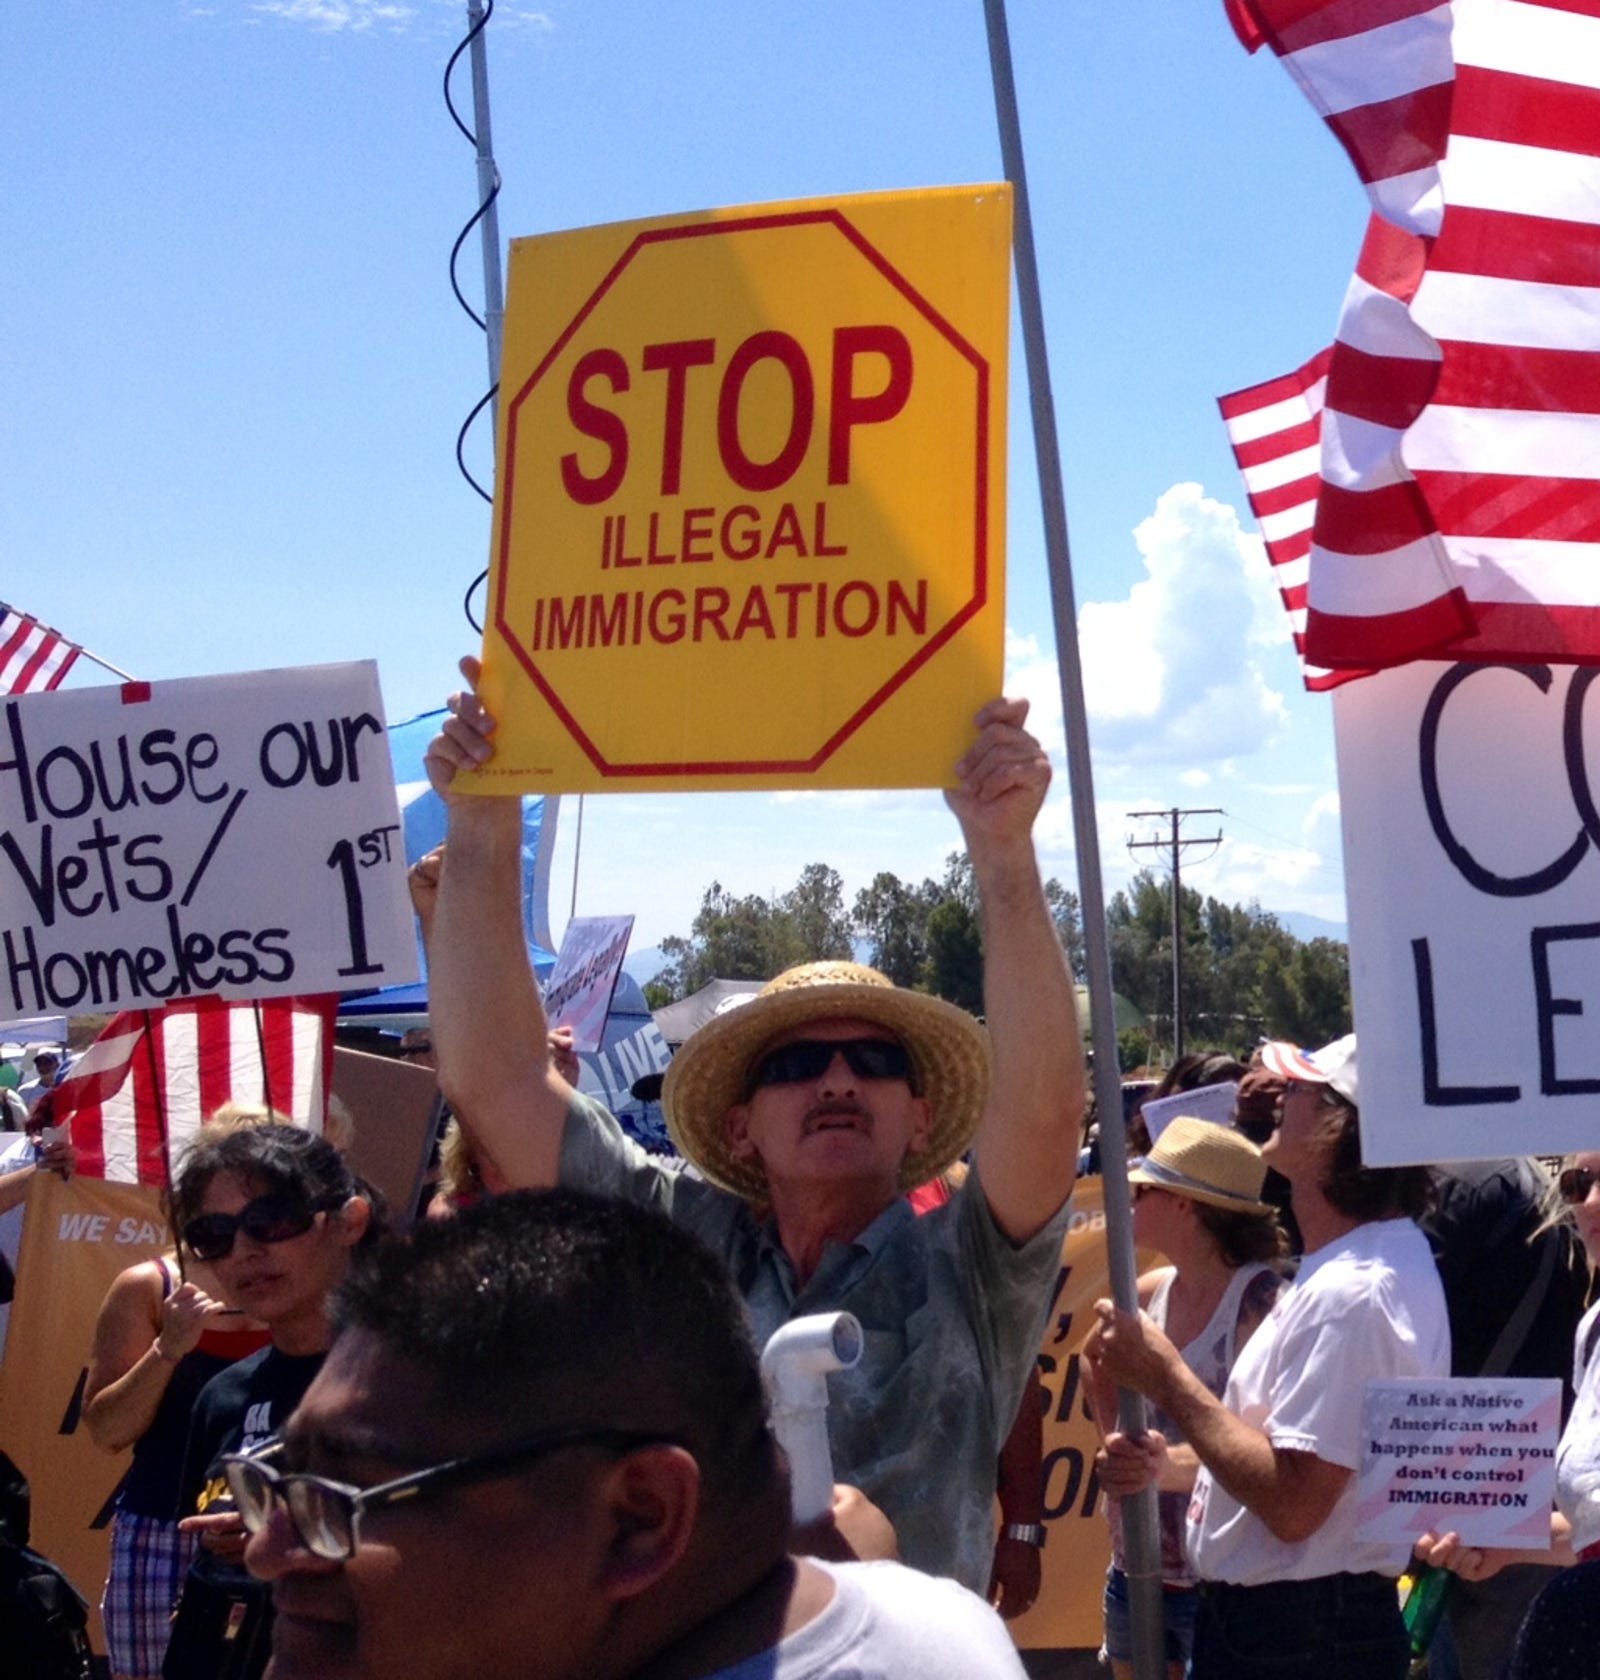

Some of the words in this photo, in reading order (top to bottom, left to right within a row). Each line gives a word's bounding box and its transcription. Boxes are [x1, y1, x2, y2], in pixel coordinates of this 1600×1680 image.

[560, 324, 914, 505] STOP
[601, 502, 848, 569] ILLEGAL
[533, 579, 928, 651] IMMIGRATION
[259, 713, 382, 788] our
[3, 904, 294, 1011] Homeless
[58, 1213, 110, 1241] WE
[1406, 1394, 1441, 1408] Ask
[1445, 1397, 1457, 1408] a
[1462, 1395, 1524, 1409] Native
[1389, 1417, 1484, 1432] American
[1489, 1419, 1538, 1434] what
[1370, 1441, 1454, 1458] happens
[1459, 1444, 1514, 1458] when
[1518, 1447, 1555, 1461] you
[1396, 1466, 1447, 1480] don't
[1452, 1468, 1524, 1482] control
[1388, 1490, 1528, 1508] IMMIGRATION
